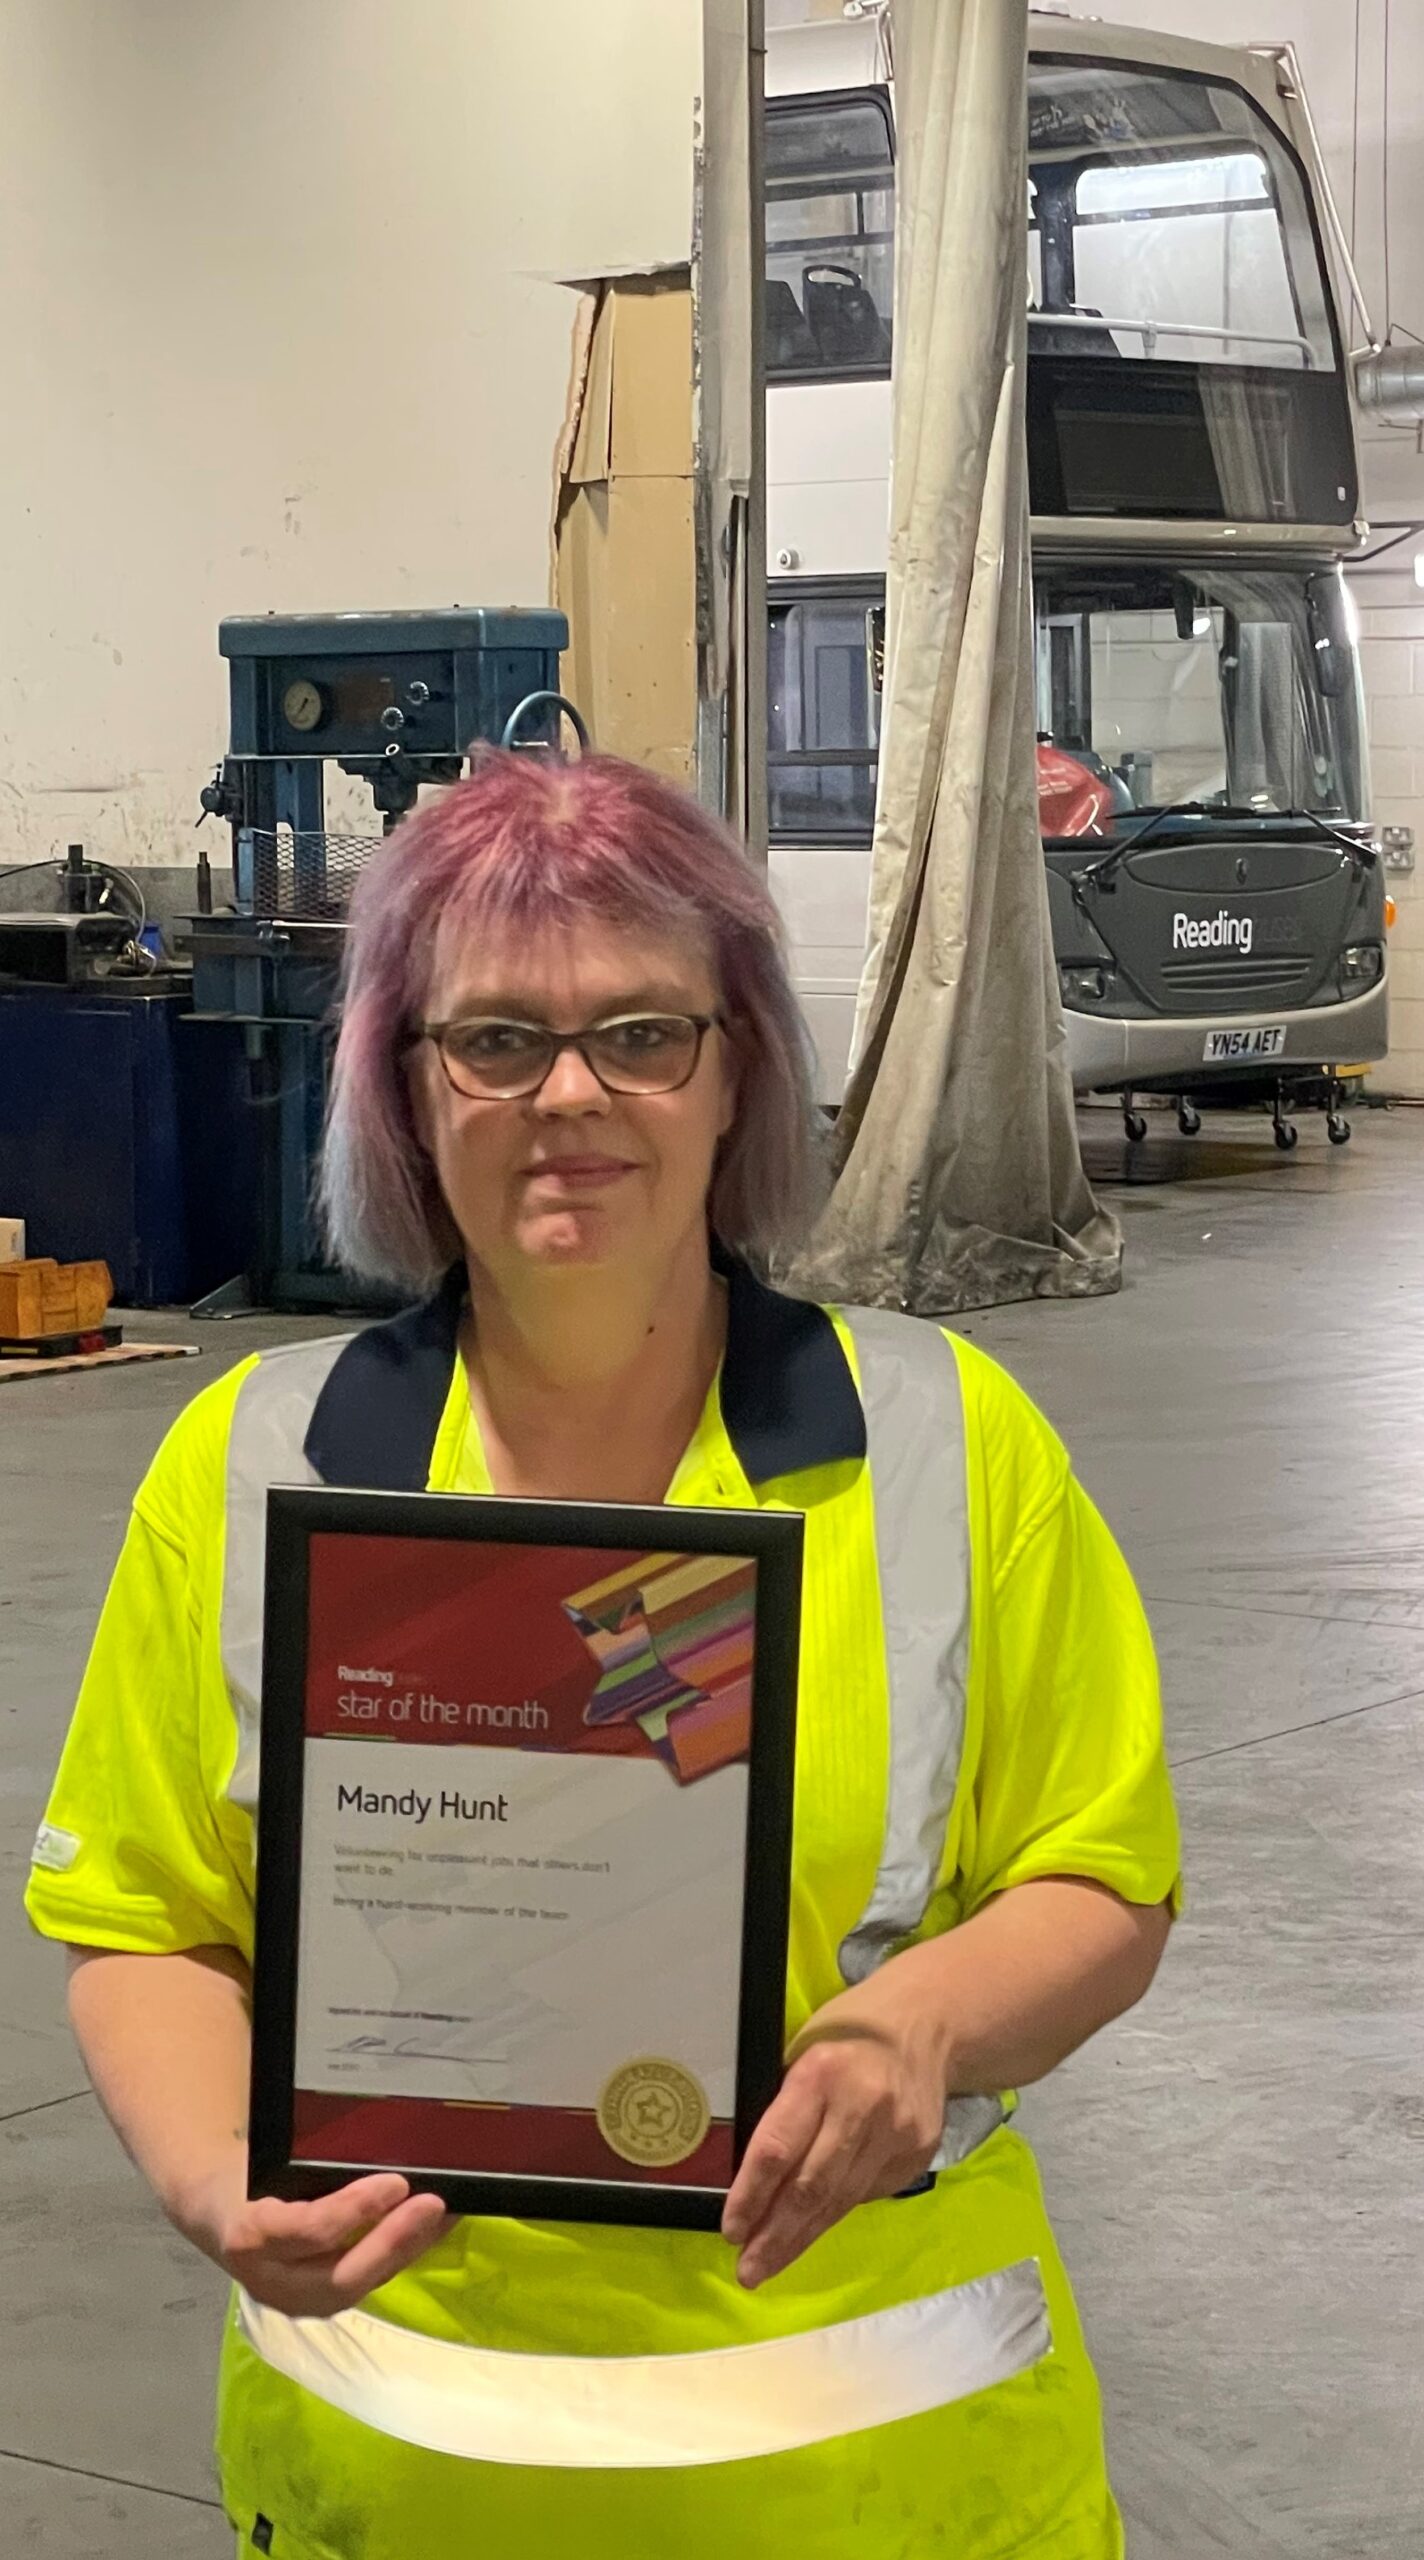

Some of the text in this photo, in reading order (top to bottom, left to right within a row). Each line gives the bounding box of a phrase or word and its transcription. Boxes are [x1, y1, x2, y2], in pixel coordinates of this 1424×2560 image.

[1172, 910, 1253, 954] Reading
[1211, 1029, 1281, 1056] YN54 AET
[337, 1664, 394, 1688] Reading
[337, 1689, 549, 1729] star of the month
[337, 1784, 509, 1824] Mandy Hunt
